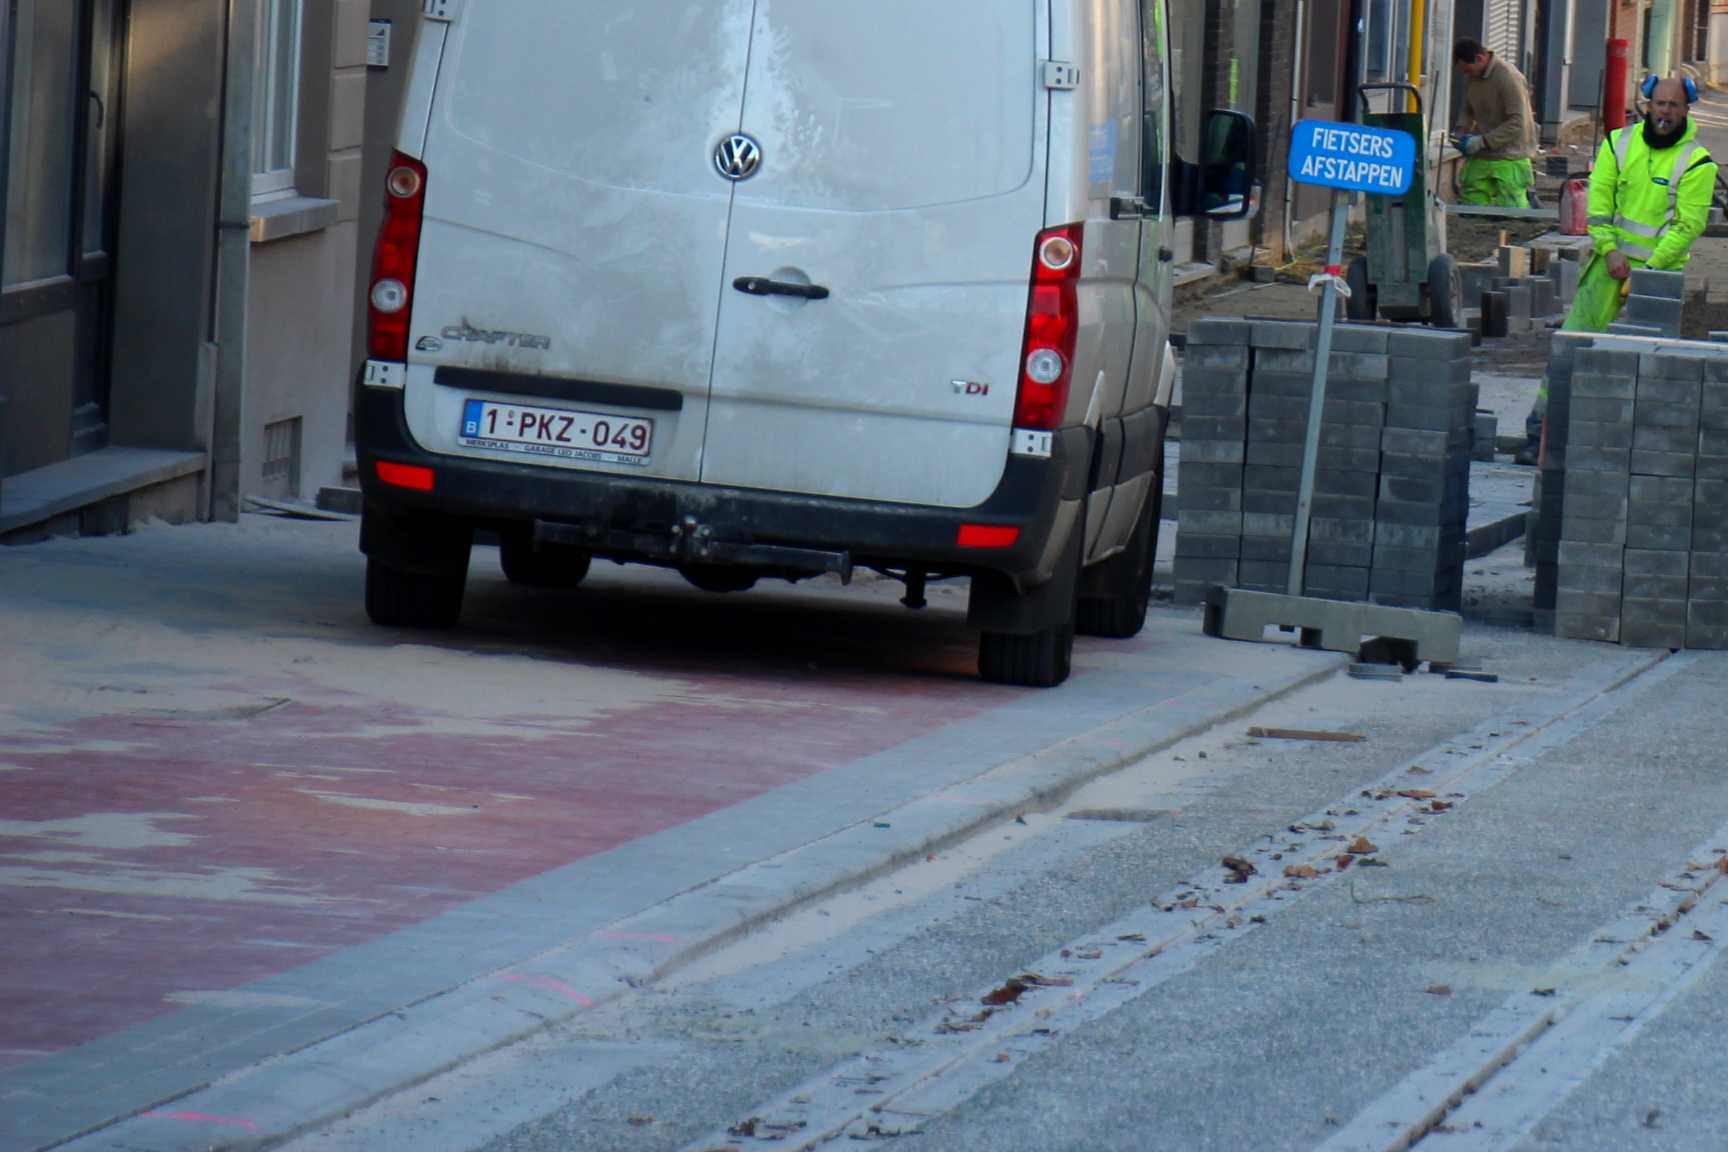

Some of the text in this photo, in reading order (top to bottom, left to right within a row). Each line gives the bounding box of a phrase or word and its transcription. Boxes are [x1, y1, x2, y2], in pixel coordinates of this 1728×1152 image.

[1312, 127, 1394, 158] FIETSERS
[1301, 155, 1403, 188] AFSTAPPEN
[951, 379, 989, 396] TDI
